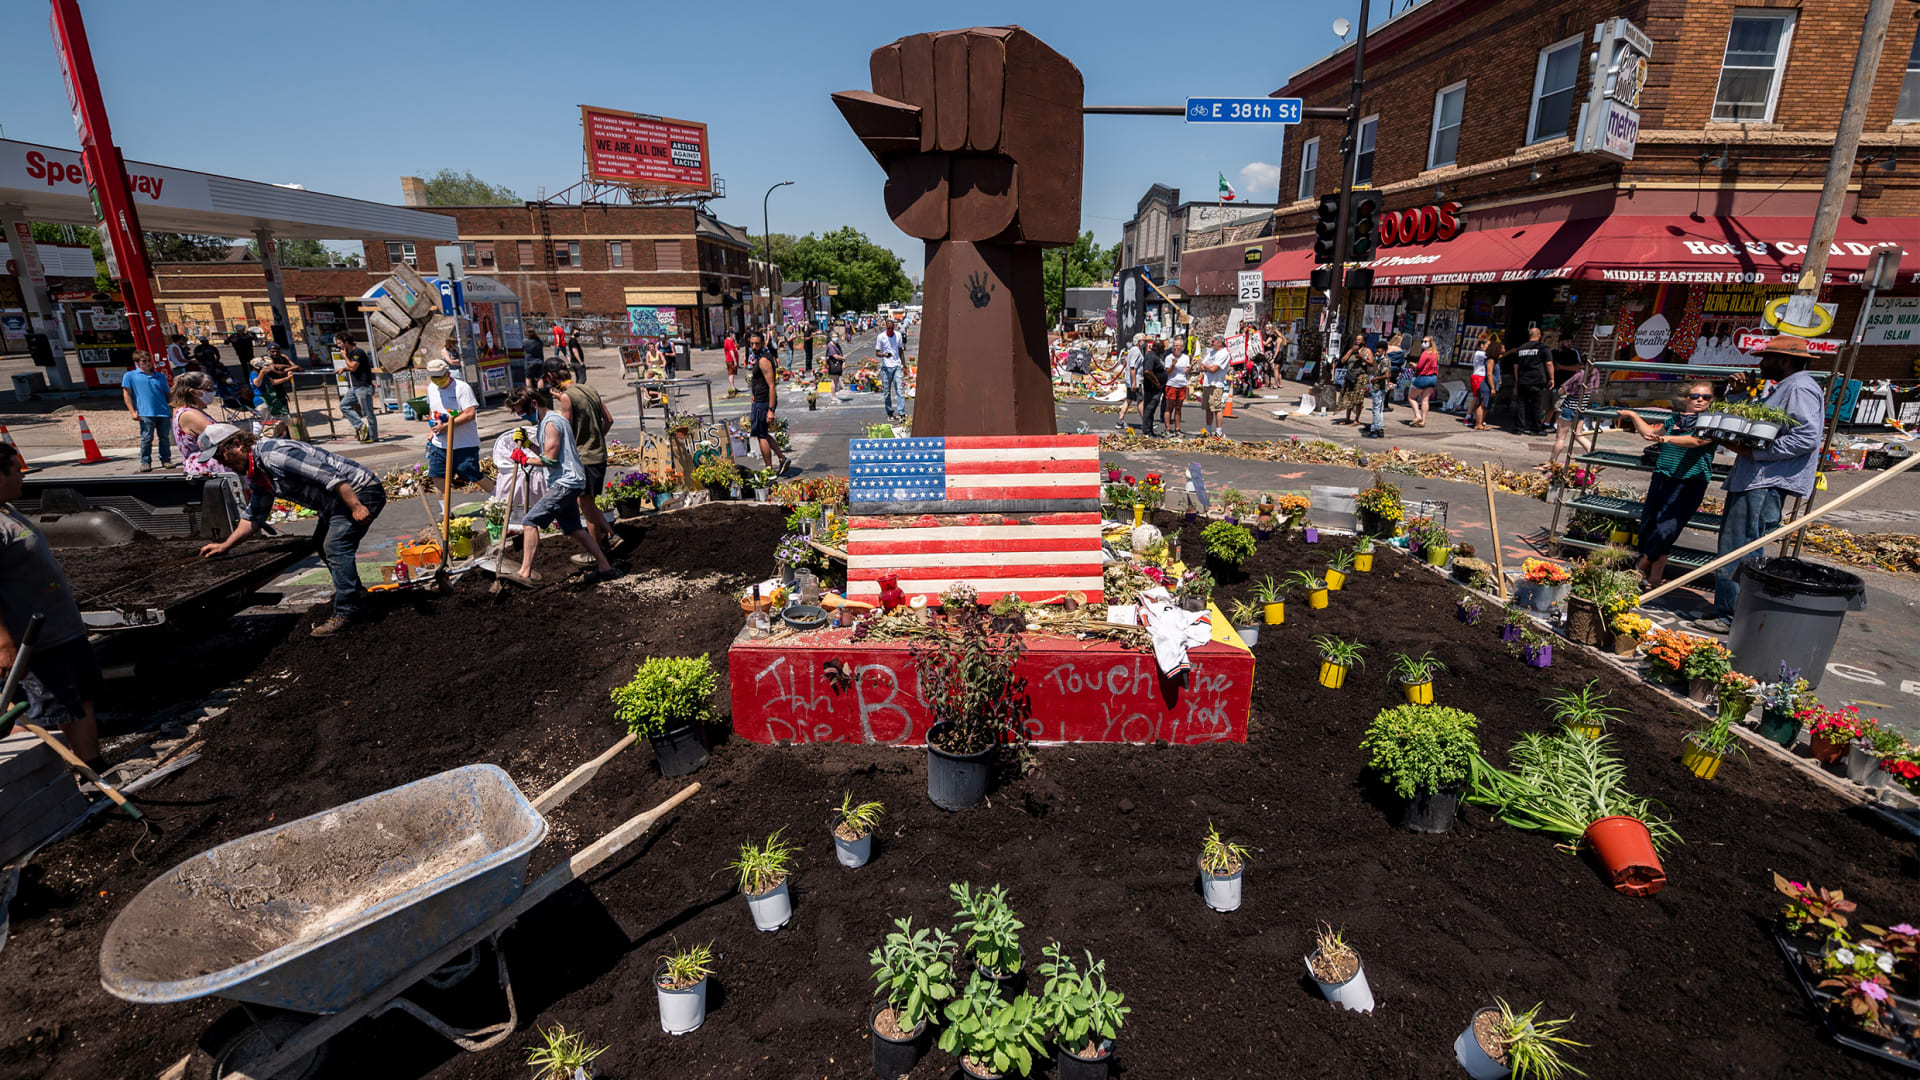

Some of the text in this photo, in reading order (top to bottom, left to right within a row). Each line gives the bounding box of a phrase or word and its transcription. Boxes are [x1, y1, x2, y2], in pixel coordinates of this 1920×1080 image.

[1212, 103, 1297, 118] E 38th St
[1608, 111, 1637, 144] metro
[596, 138, 668, 158] WE ARE ALL ONE
[672, 142, 699, 151] ARTISTS
[673, 150, 700, 160] AGAINST
[674, 159, 700, 168] RACISM
[26, 151, 163, 200] Speway
[1379, 201, 1462, 246] OODS
[1682, 241, 1741, 255] Hot
[1744, 241, 1768, 255] &
[1776, 241, 1846, 255] Cod
[1394, 275, 1427, 285] T-SHIRTS
[1431, 272, 1469, 283] MEXICAN
[1470, 271, 1496, 282] FOOD
[1501, 269, 1537, 281] HALAL
[1536, 267, 1573, 279] MEAT
[1601, 269, 1833, 283] MIDDLE EASTERN FOOD CHE
[1241, 287, 1261, 300] 25
[1704, 294, 1730, 312] BEING
[1729, 294, 1757, 313] BLACK
[1635, 335, 1668, 346] breathe
[1883, 329, 1912, 341] ISLAM
[1044, 657, 1155, 699] Touch
